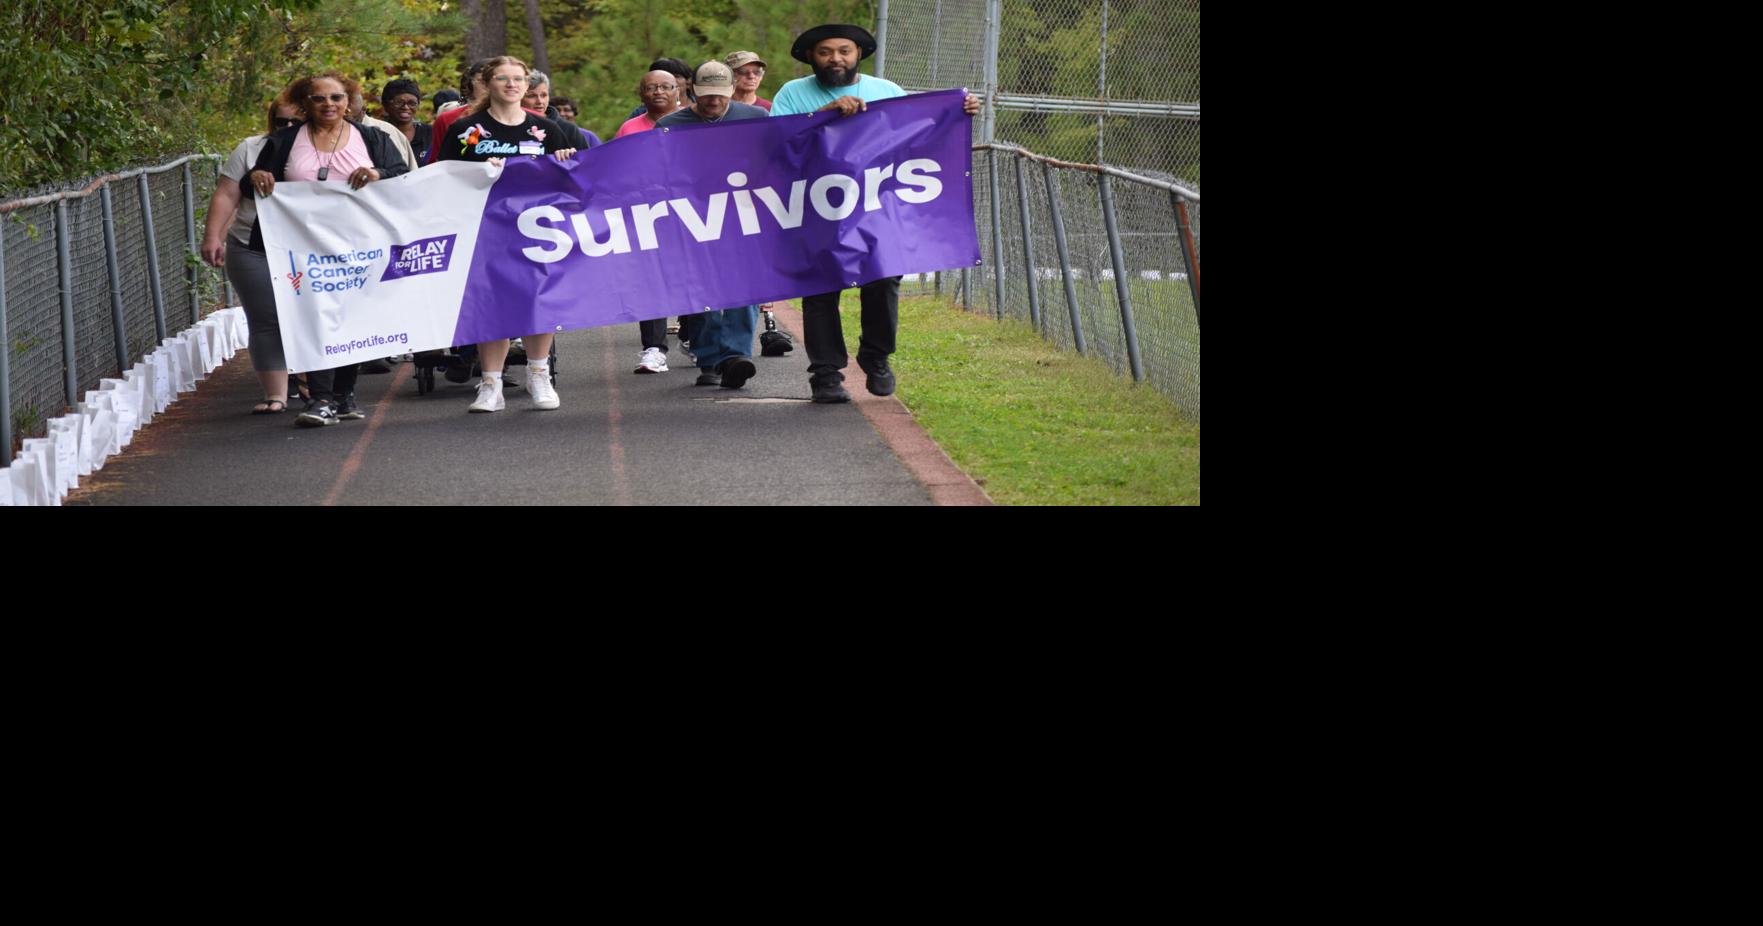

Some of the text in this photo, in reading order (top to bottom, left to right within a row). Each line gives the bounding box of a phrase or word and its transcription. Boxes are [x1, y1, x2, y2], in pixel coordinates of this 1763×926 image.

[475, 140, 518, 154] Ballet
[517, 158, 943, 263] Survivors
[307, 248, 383, 266] American
[401, 240, 448, 261] RELAY
[308, 265, 369, 279] Cancer
[395, 255, 443, 272] FOR LIFE
[311, 276, 368, 293] Society
[325, 332, 408, 356] RelayForLife.org
